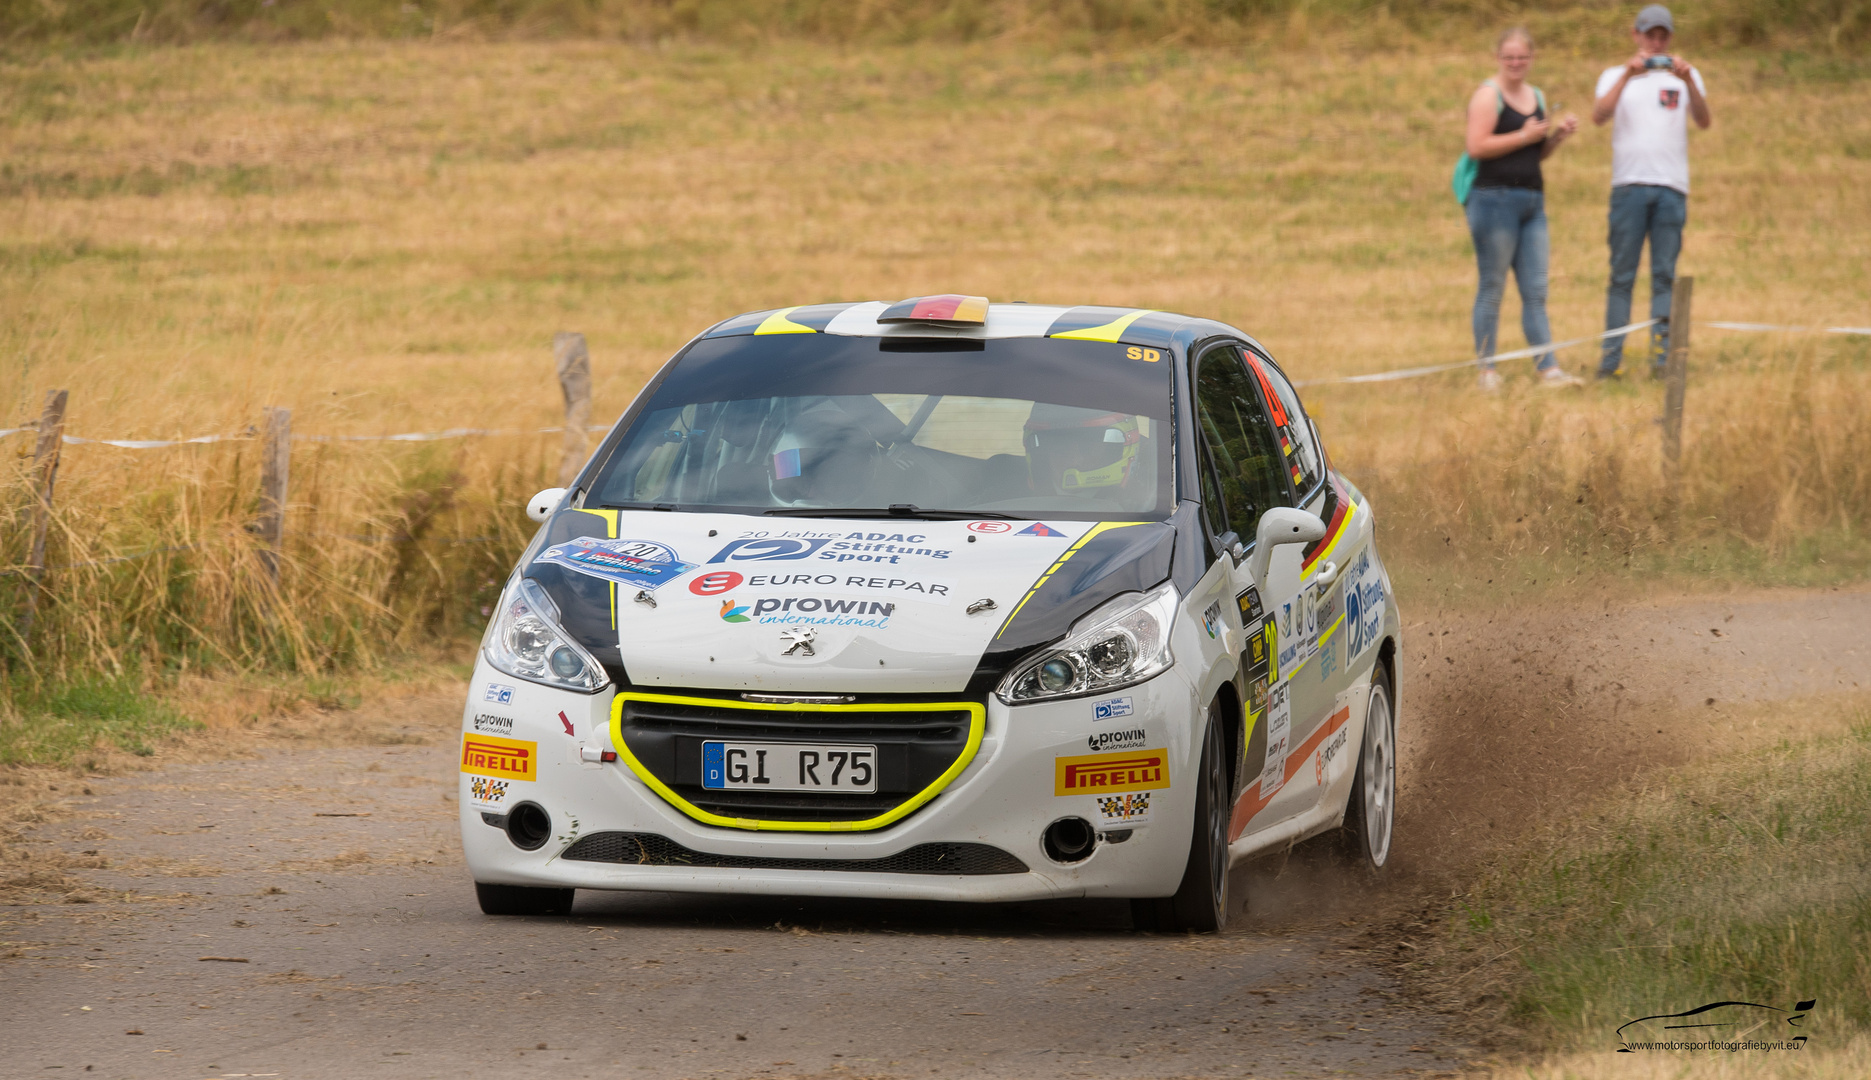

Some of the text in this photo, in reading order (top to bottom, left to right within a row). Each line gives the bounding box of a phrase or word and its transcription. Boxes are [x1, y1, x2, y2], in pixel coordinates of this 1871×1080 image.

[1126, 346, 1161, 363] SD
[737, 530, 927, 543] 20 Jahre ADAC
[620, 543, 659, 557] 20
[818, 551, 901, 564] Sport
[832, 541, 953, 559] Stiftung
[749, 574, 949, 596] EURO REPAR
[759, 611, 889, 630] international
[1265, 620, 1277, 685] 20
[1102, 740, 1147, 751] international
[463, 741, 529, 773] PIRELLI
[710, 769, 719, 780] D
[726, 748, 770, 784] GI
[1065, 757, 1161, 788] PIRELLI
